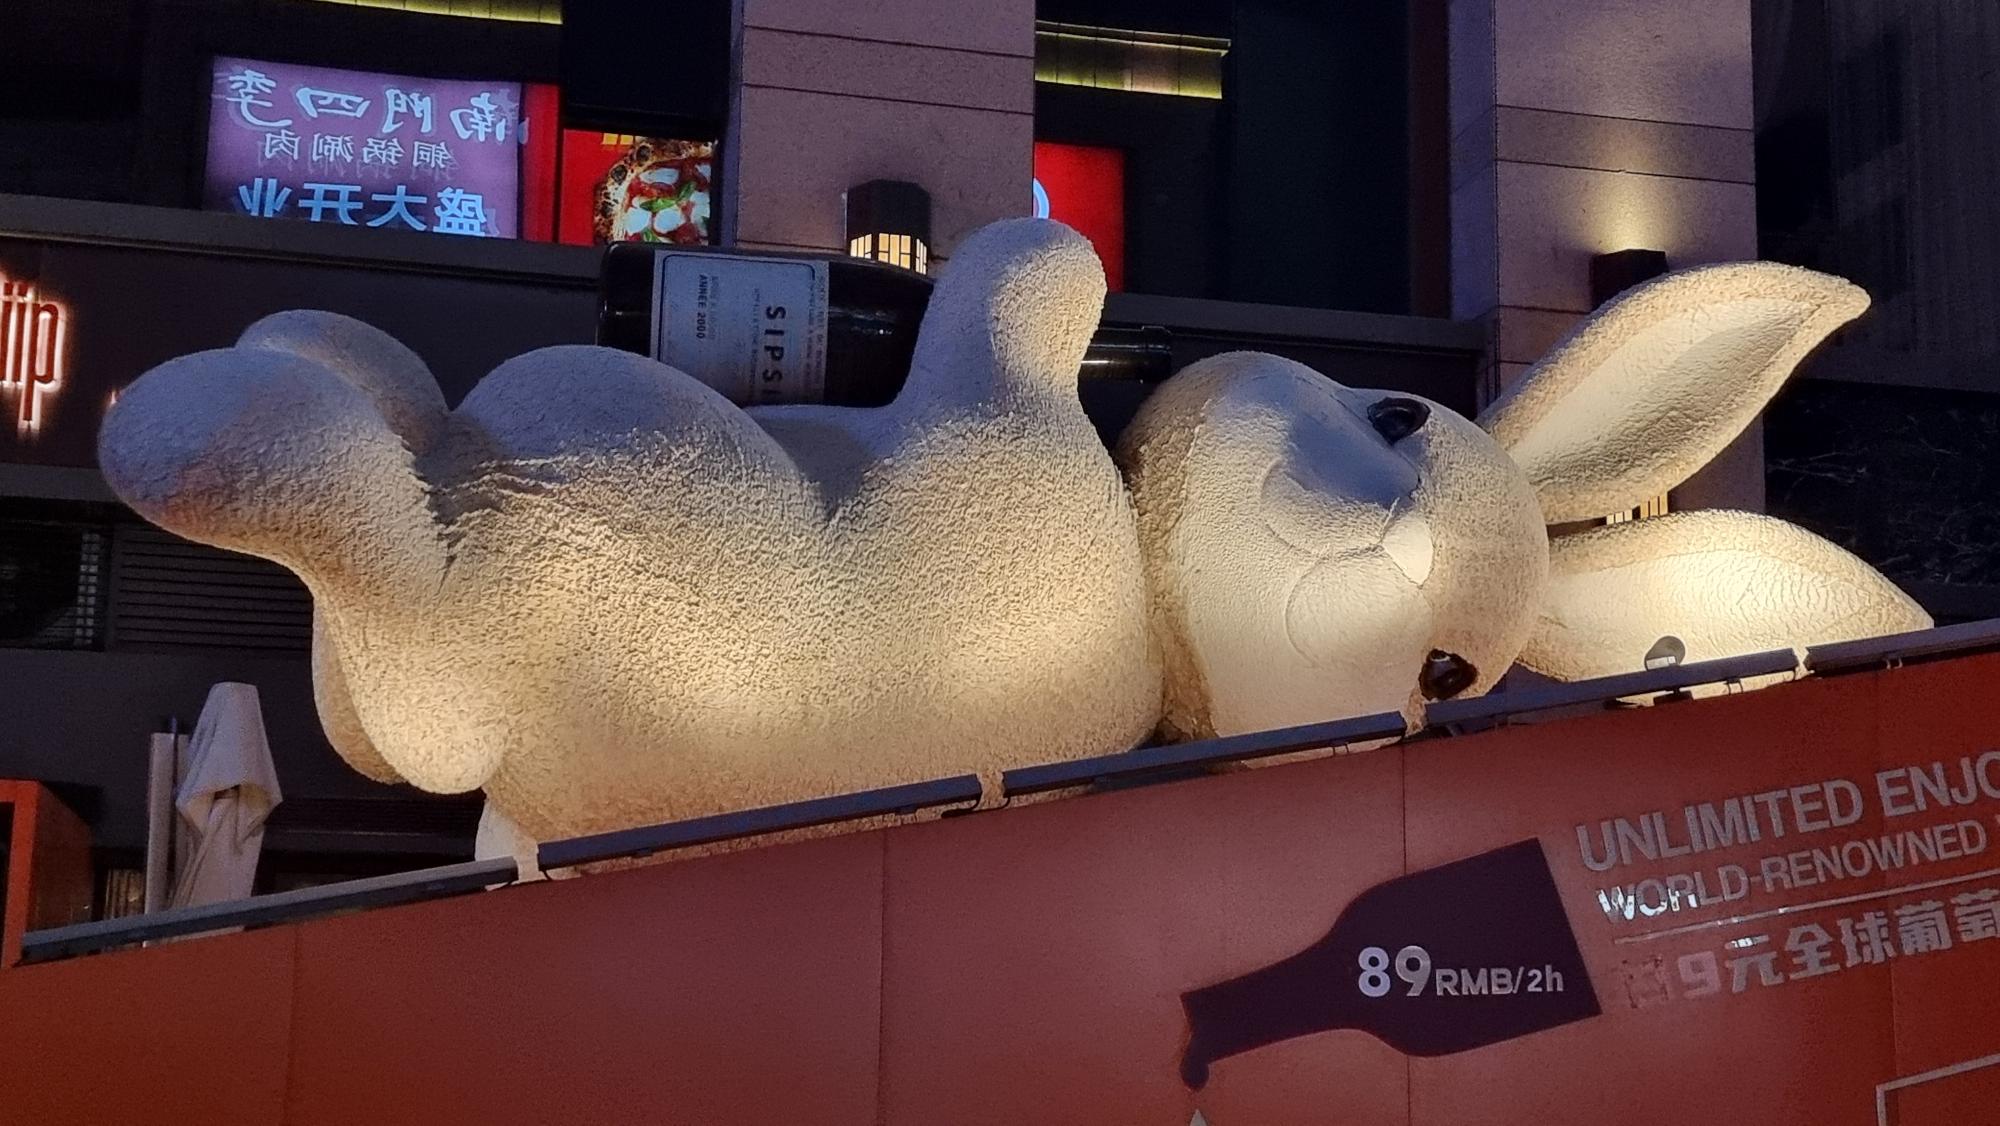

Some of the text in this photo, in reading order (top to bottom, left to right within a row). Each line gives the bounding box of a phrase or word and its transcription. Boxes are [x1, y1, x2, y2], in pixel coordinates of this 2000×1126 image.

[696, 312, 707, 340] 2000
[1576, 779, 1864, 872] UNLIMITED
[1597, 820, 1988, 924] WORLD-RENOWNED
